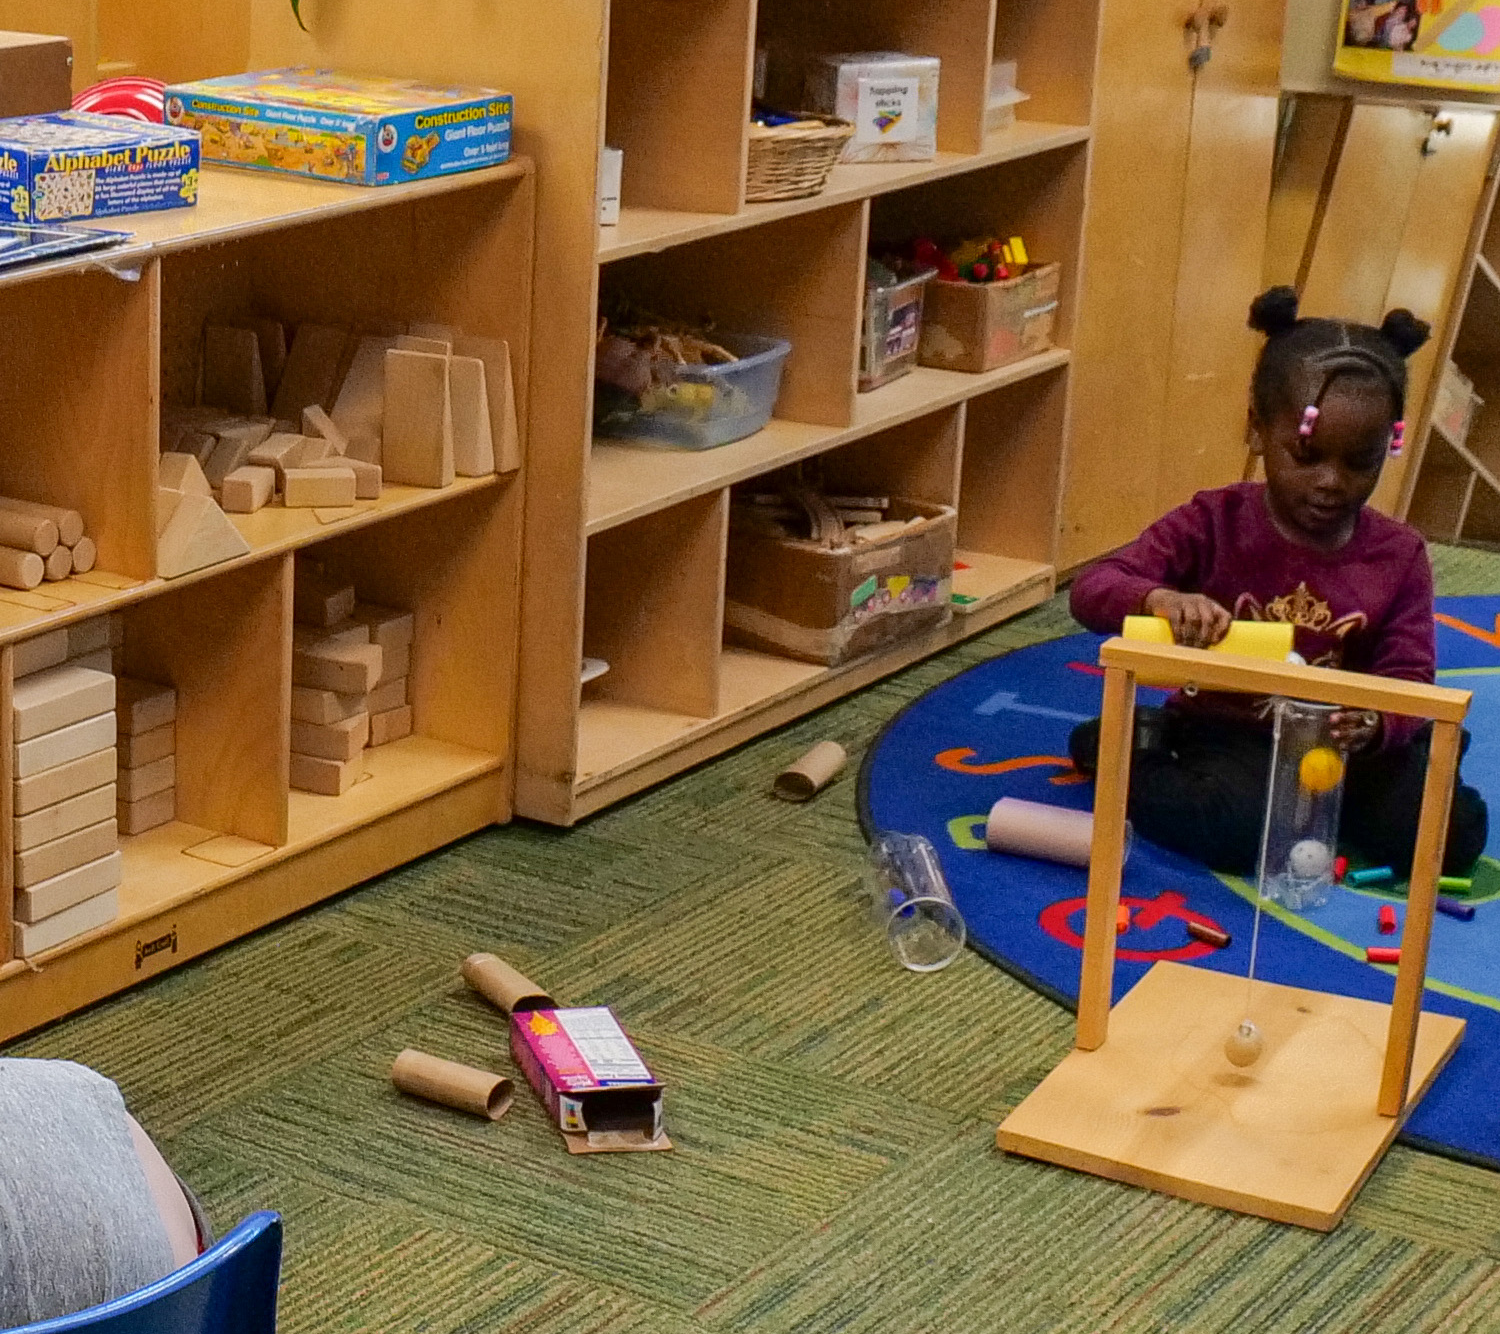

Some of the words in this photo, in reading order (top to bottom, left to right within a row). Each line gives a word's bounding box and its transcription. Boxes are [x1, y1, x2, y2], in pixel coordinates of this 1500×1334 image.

[192, 100, 241, 115] Construction
[243, 105, 260, 116] Site
[415, 107, 486, 129] Construction
[488, 102, 510, 116] Site
[45, 149, 132, 176] Alphabet
[136, 141, 191, 163] Puzzle
[1039, 890, 1223, 963] Q
